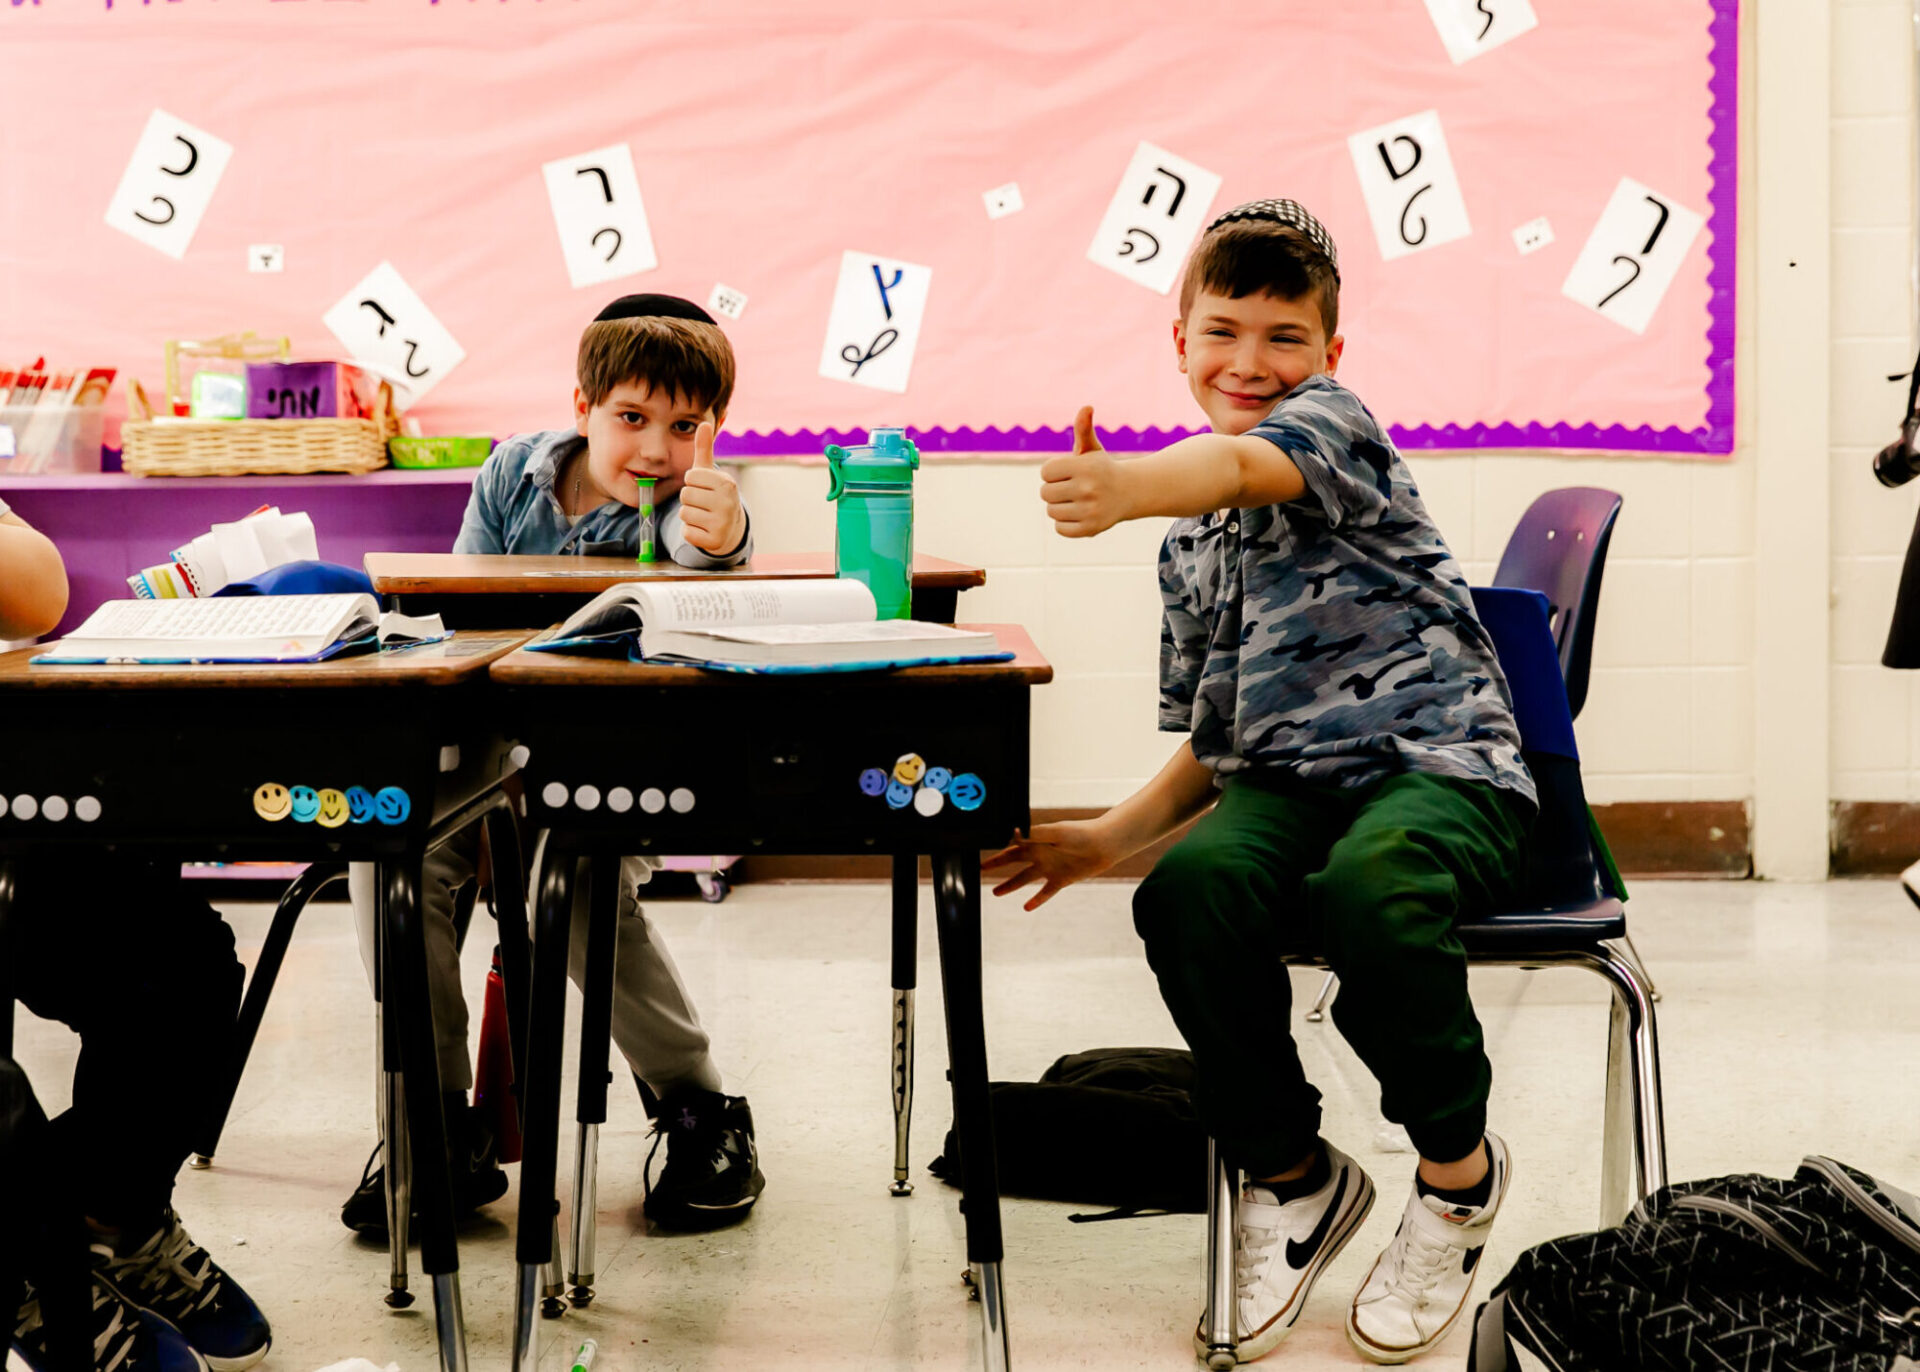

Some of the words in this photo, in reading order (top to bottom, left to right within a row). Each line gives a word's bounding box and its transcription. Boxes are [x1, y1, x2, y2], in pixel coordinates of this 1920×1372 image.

[160, 135, 198, 177] כ
[1377, 135, 1422, 181] ט
[576, 167, 614, 203] ר
[1141, 167, 1187, 218] ה
[135, 196, 175, 225] כ
[1400, 184, 1432, 246] ט
[1118, 228, 1160, 263] ה
[871, 264, 903, 321] ץ
[360, 299, 396, 337] ג
